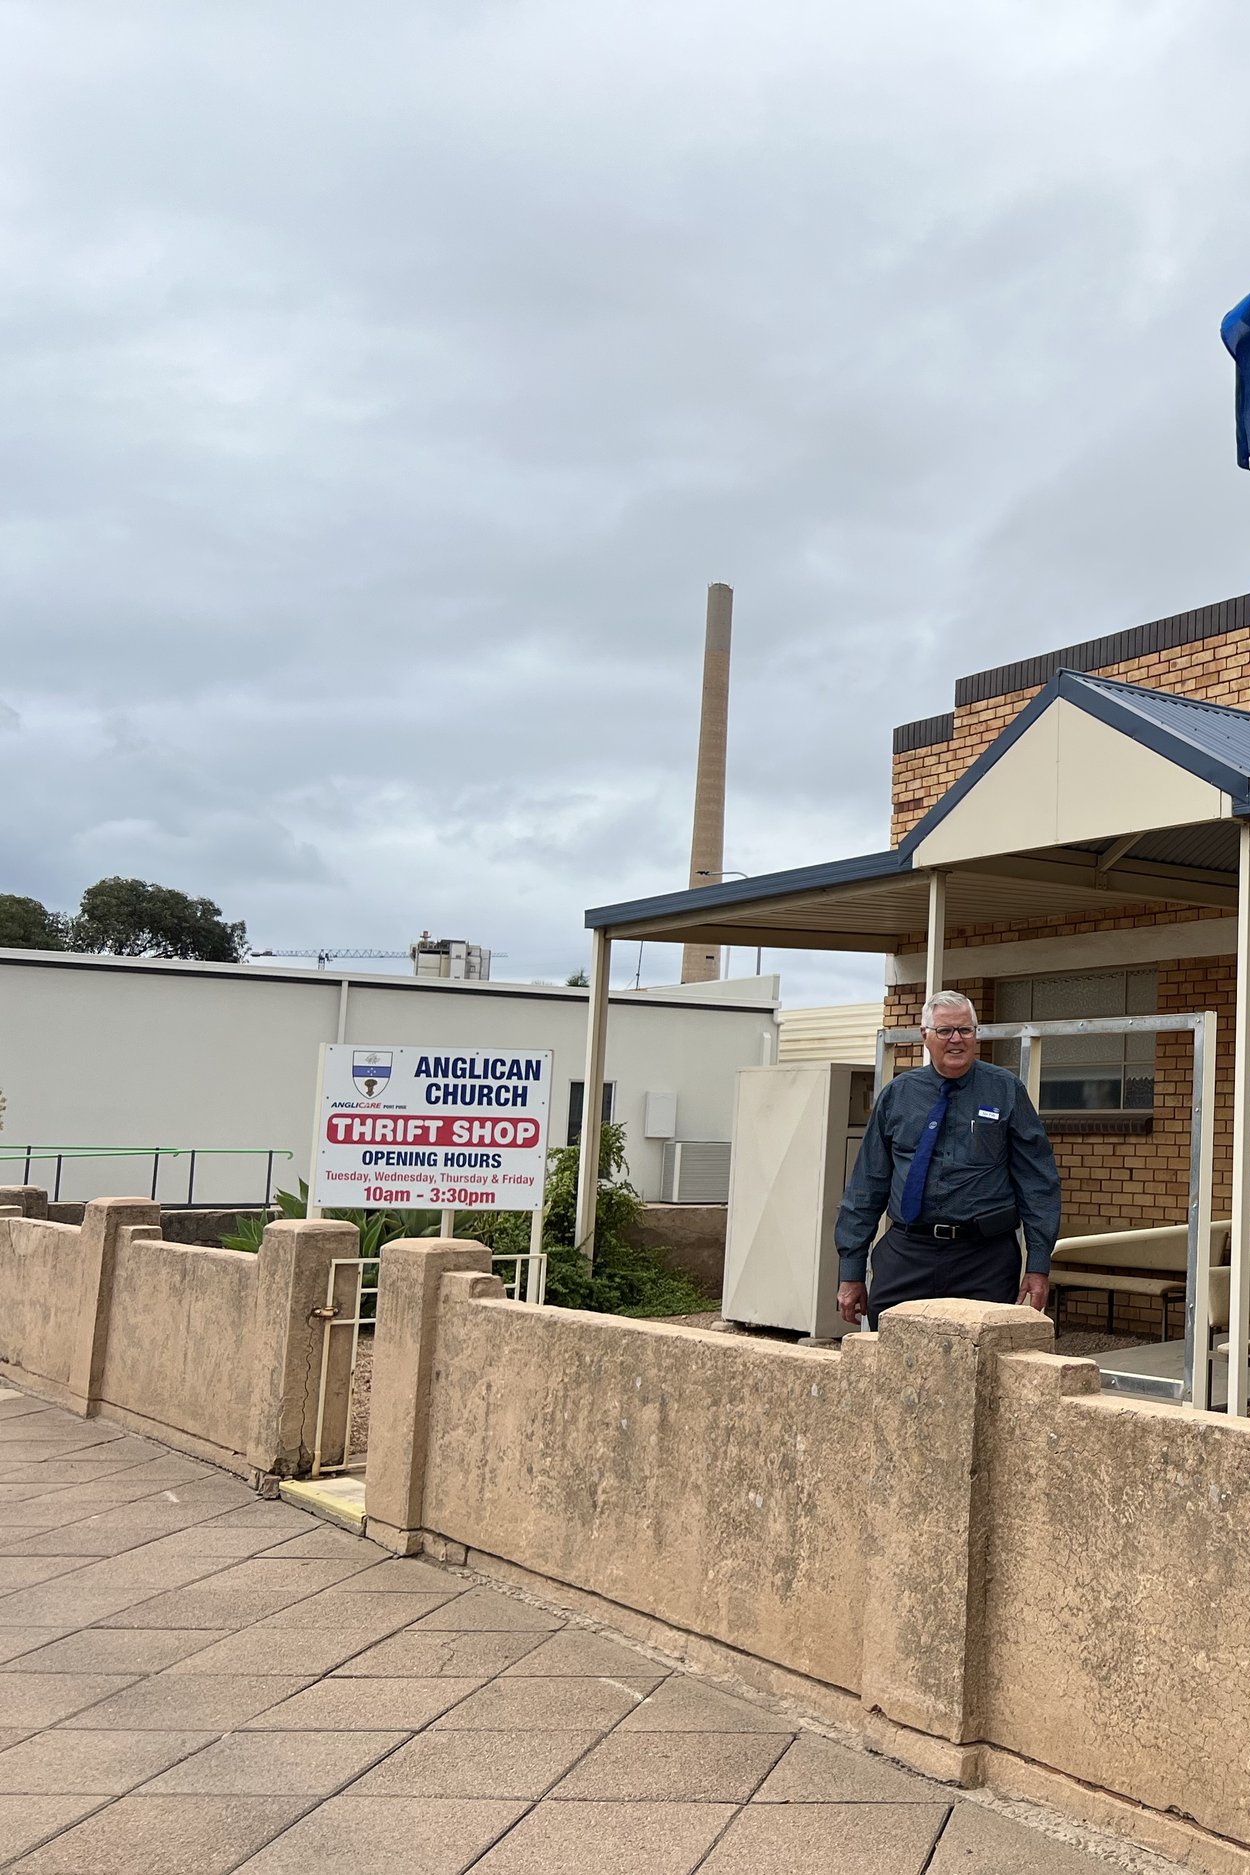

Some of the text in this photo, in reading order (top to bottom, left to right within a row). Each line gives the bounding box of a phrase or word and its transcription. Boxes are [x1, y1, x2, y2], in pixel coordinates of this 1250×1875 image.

[414, 1056, 542, 1081] ANGLICAN
[425, 1083, 528, 1107] CHURCH
[331, 1117, 536, 1145] THRIFT SHOP
[362, 1150, 502, 1169] OPENING HOURS
[326, 1170, 535, 1186] Tuesday, Wednesday, Thursday & Friday
[364, 1186, 411, 1202] 10am
[430, 1188, 496, 1206] 3:30pm
